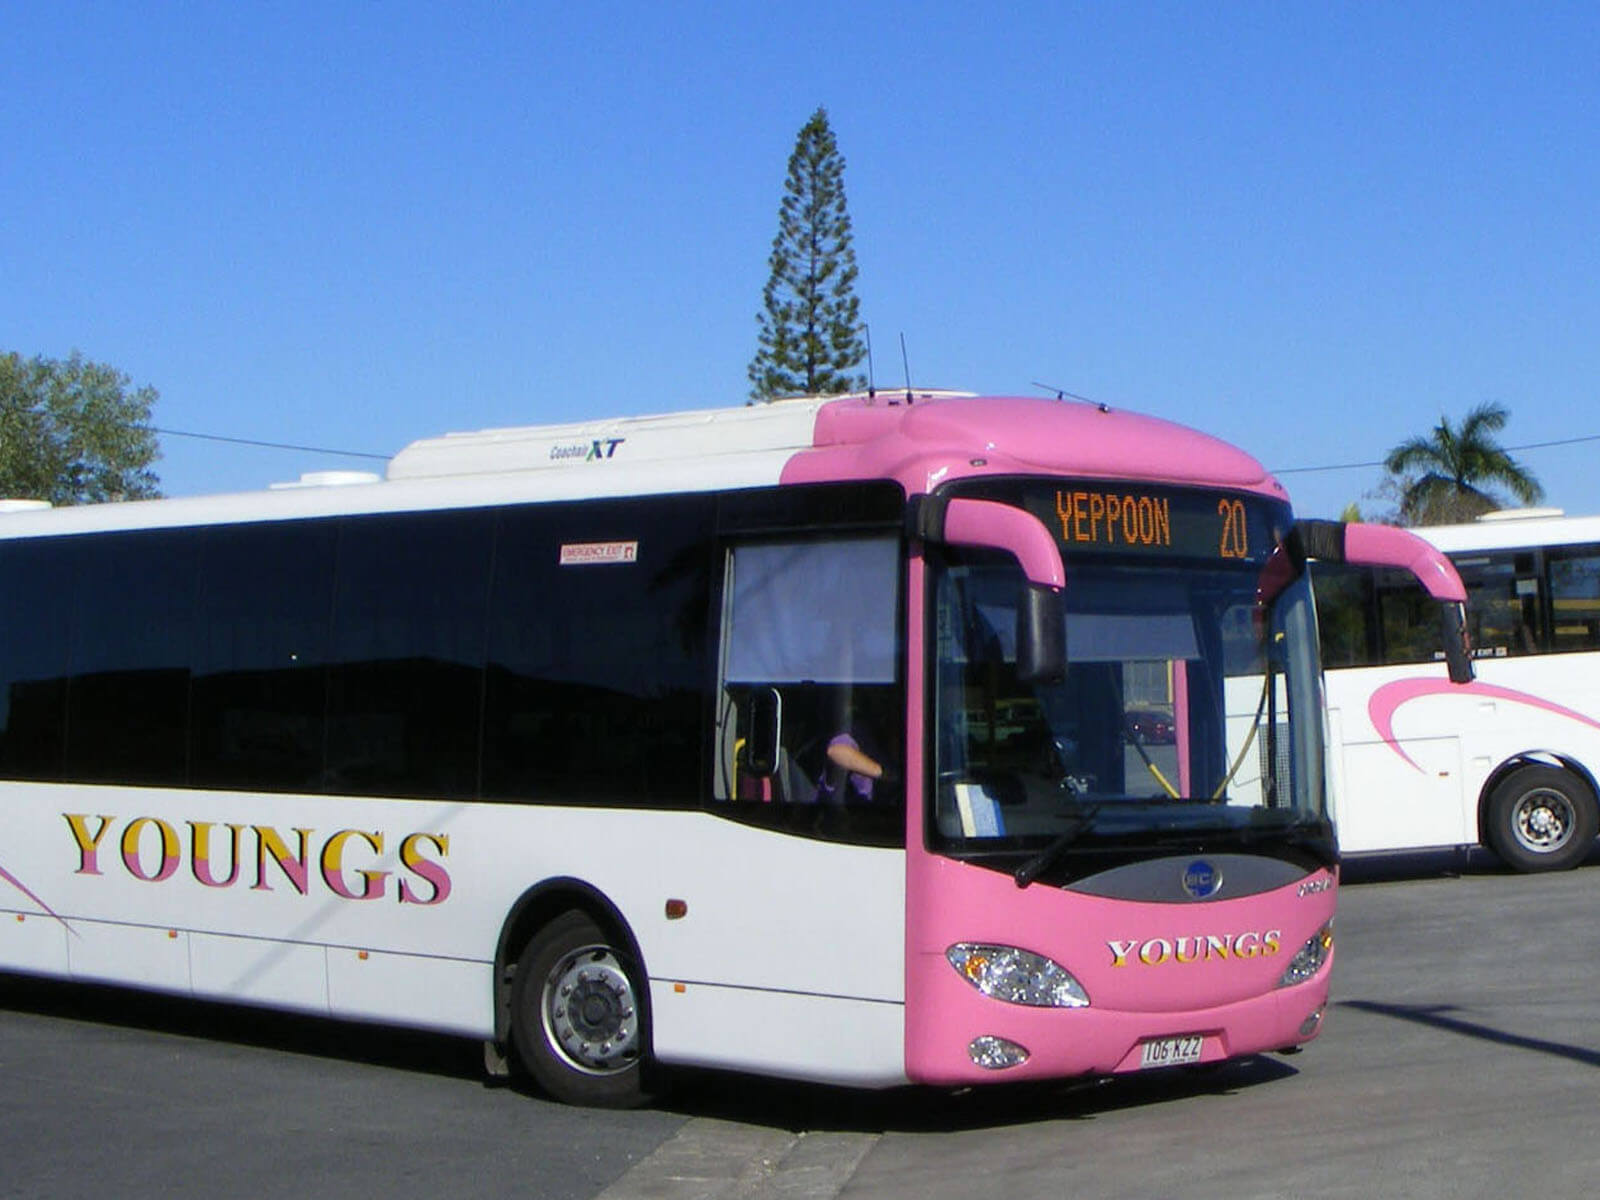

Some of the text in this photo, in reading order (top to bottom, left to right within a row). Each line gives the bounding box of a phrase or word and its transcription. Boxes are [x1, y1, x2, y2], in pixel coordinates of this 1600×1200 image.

[585, 437, 625, 461] XT
[1056, 490, 1248, 558] YEPPOON 20
[61, 812, 452, 906] YOUNGS
[1107, 930, 1281, 967] YOUNGS
[1145, 1036, 1200, 1061] 106 KZZ
